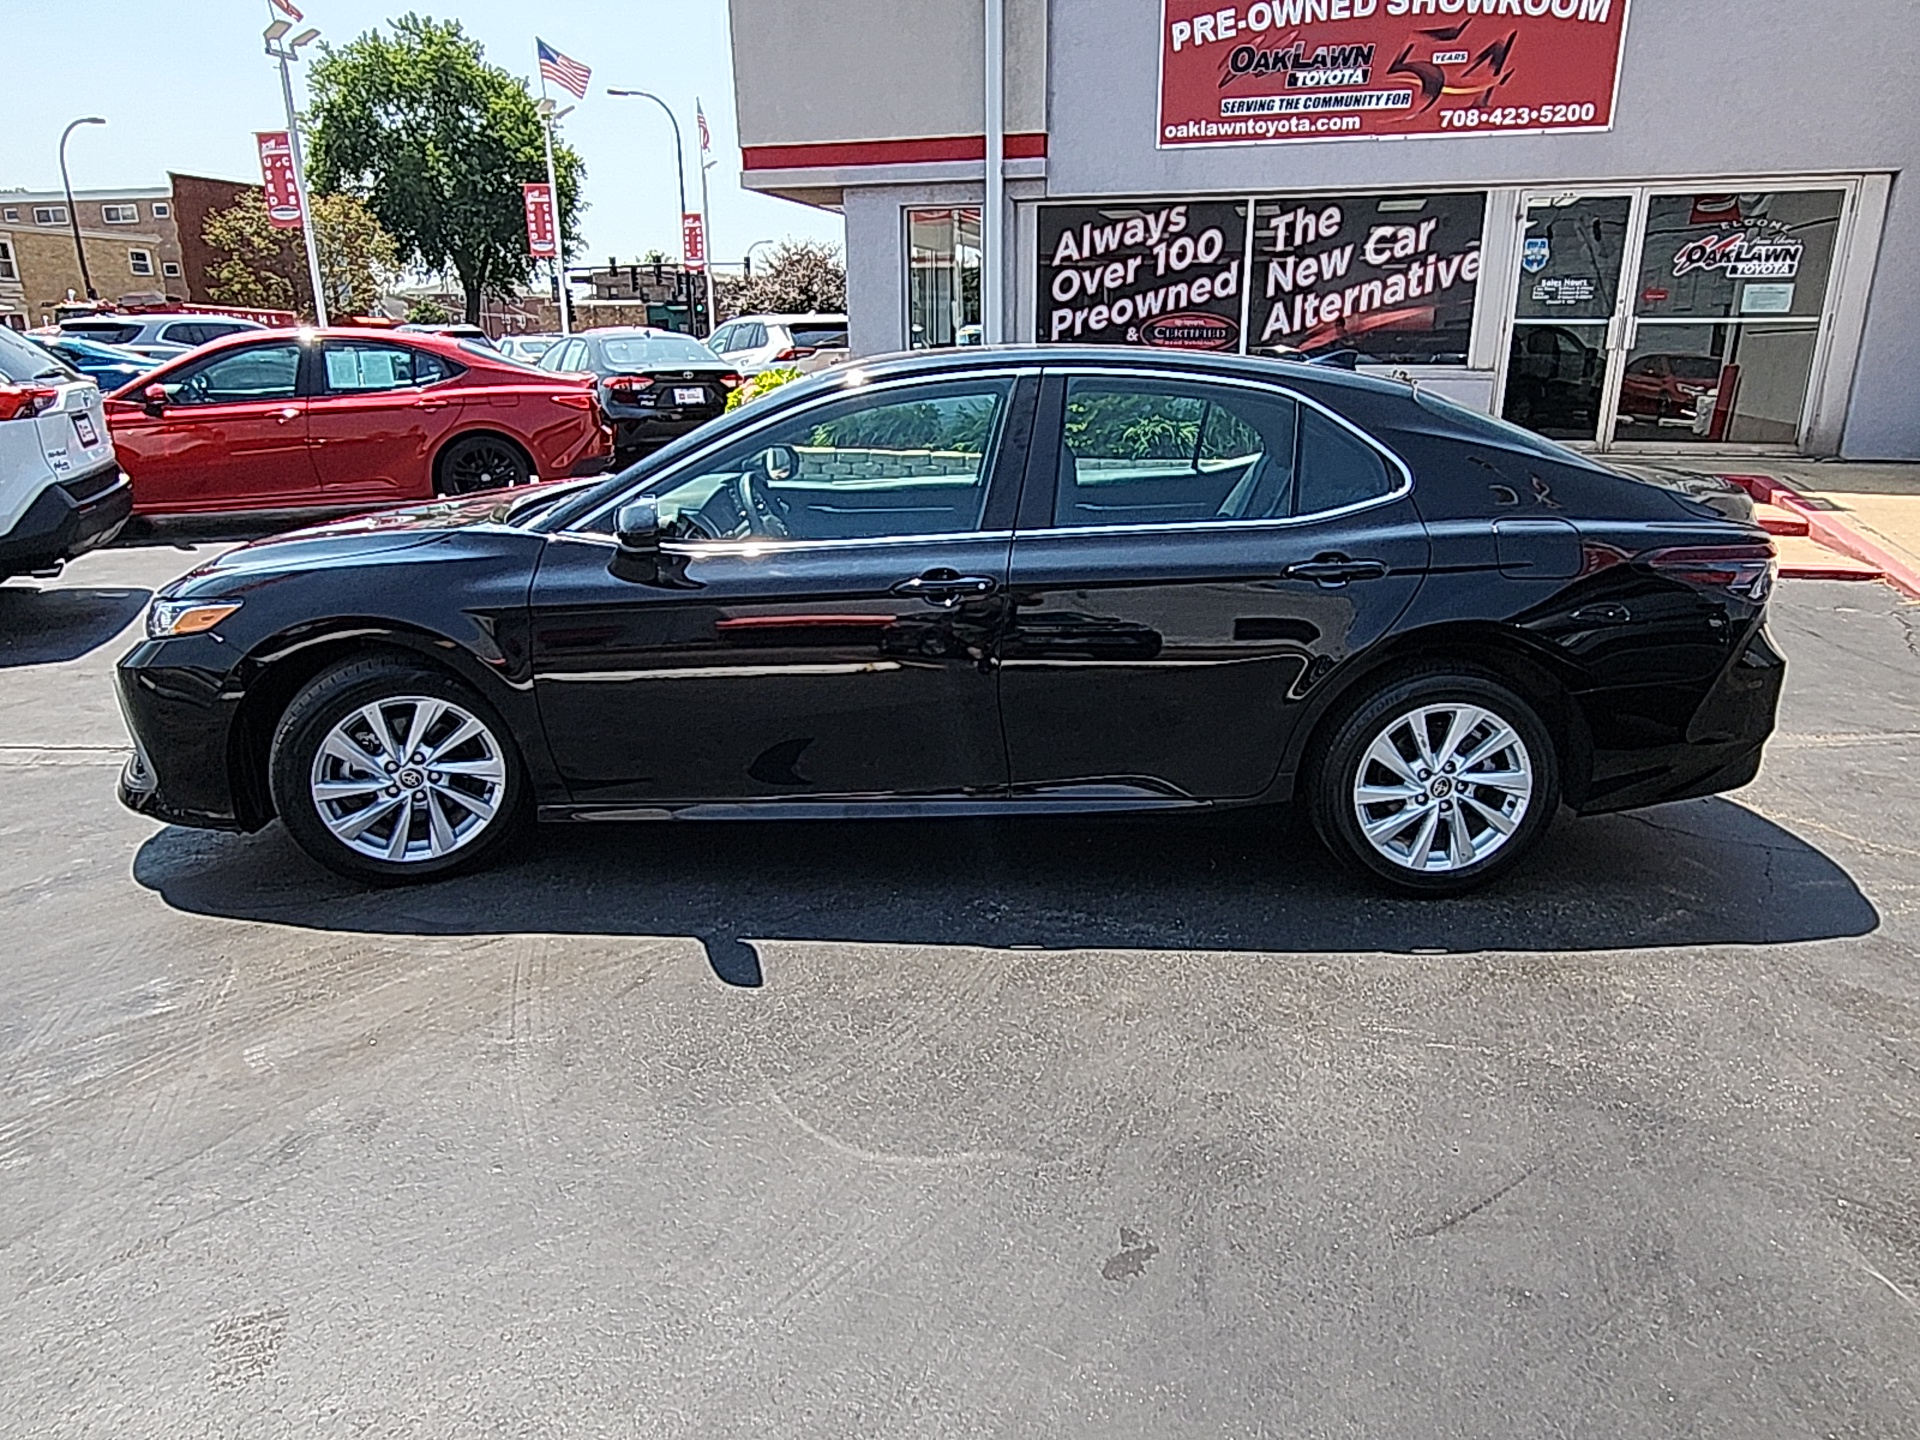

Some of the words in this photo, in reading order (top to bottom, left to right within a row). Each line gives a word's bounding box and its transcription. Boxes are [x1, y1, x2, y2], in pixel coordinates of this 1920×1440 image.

[1171, 0, 1378, 52] PRE-OWNED
[1295, 69, 1364, 86] TOYOTA
[1434, 52, 1467, 62] YEARS
[1164, 115, 1361, 138] oaklawntoyota.com
[1221, 98, 1275, 114] SERVING
[1278, 97, 1301, 111] THE
[1302, 92, 1386, 110] COMMUNITY
[1385, 92, 1411, 106] FOR
[281, 156, 298, 205] CARS
[1051, 205, 1188, 267] Always
[1269, 205, 1343, 253] The
[1051, 254, 1143, 302] Over
[1153, 228, 1224, 277] 100
[1265, 242, 1355, 299] New
[1364, 216, 1438, 266] Car
[1737, 263, 1790, 274] TOYOTA
[1050, 258, 1241, 341] Preowned
[1259, 248, 1481, 342] Alternative
[1126, 326, 1139, 342] &
